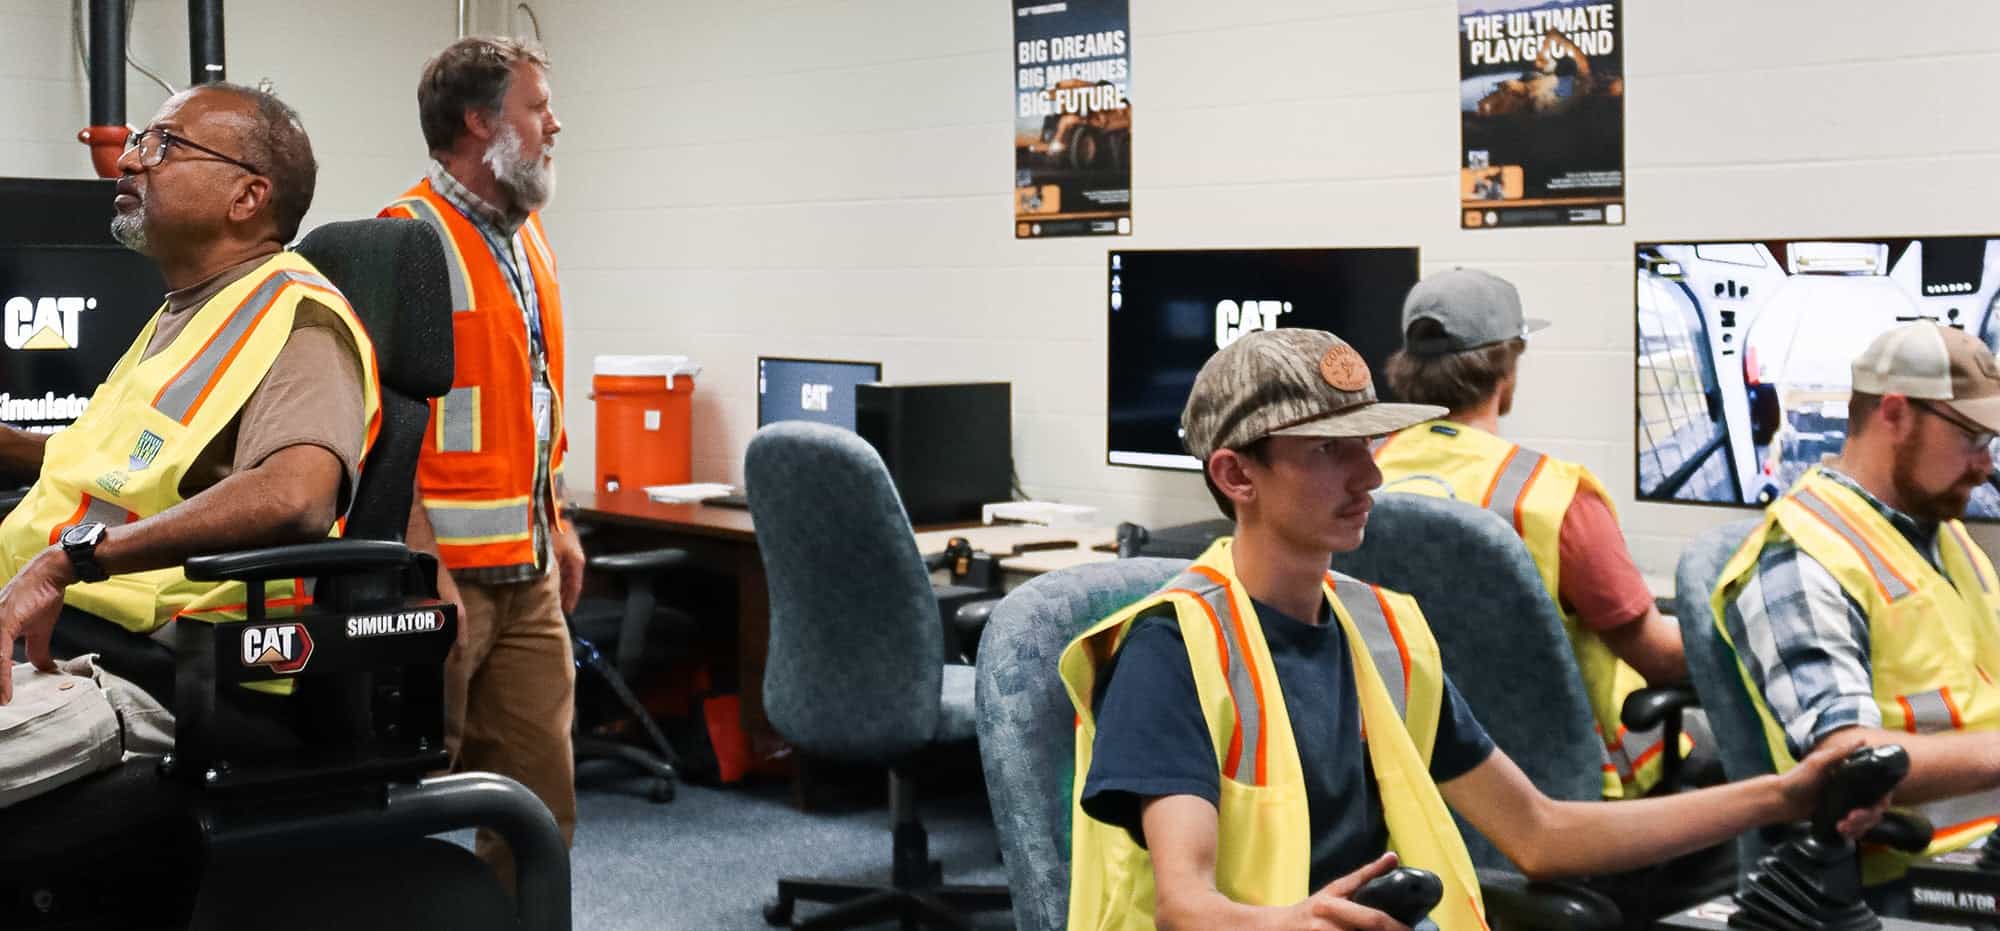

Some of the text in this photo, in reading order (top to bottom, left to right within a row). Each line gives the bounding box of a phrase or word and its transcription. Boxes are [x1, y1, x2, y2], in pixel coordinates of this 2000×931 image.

[1463, 4, 1614, 41] THE ULTIMATE
[1018, 30, 1126, 64] BIG DREAMS
[1018, 58, 1127, 89] BIG MACHINES
[1020, 84, 1127, 117] BIG FUTURE
[4, 296, 85, 349] CAT
[347, 612, 436, 637] SIMULATOR
[243, 625, 296, 664] CAT
